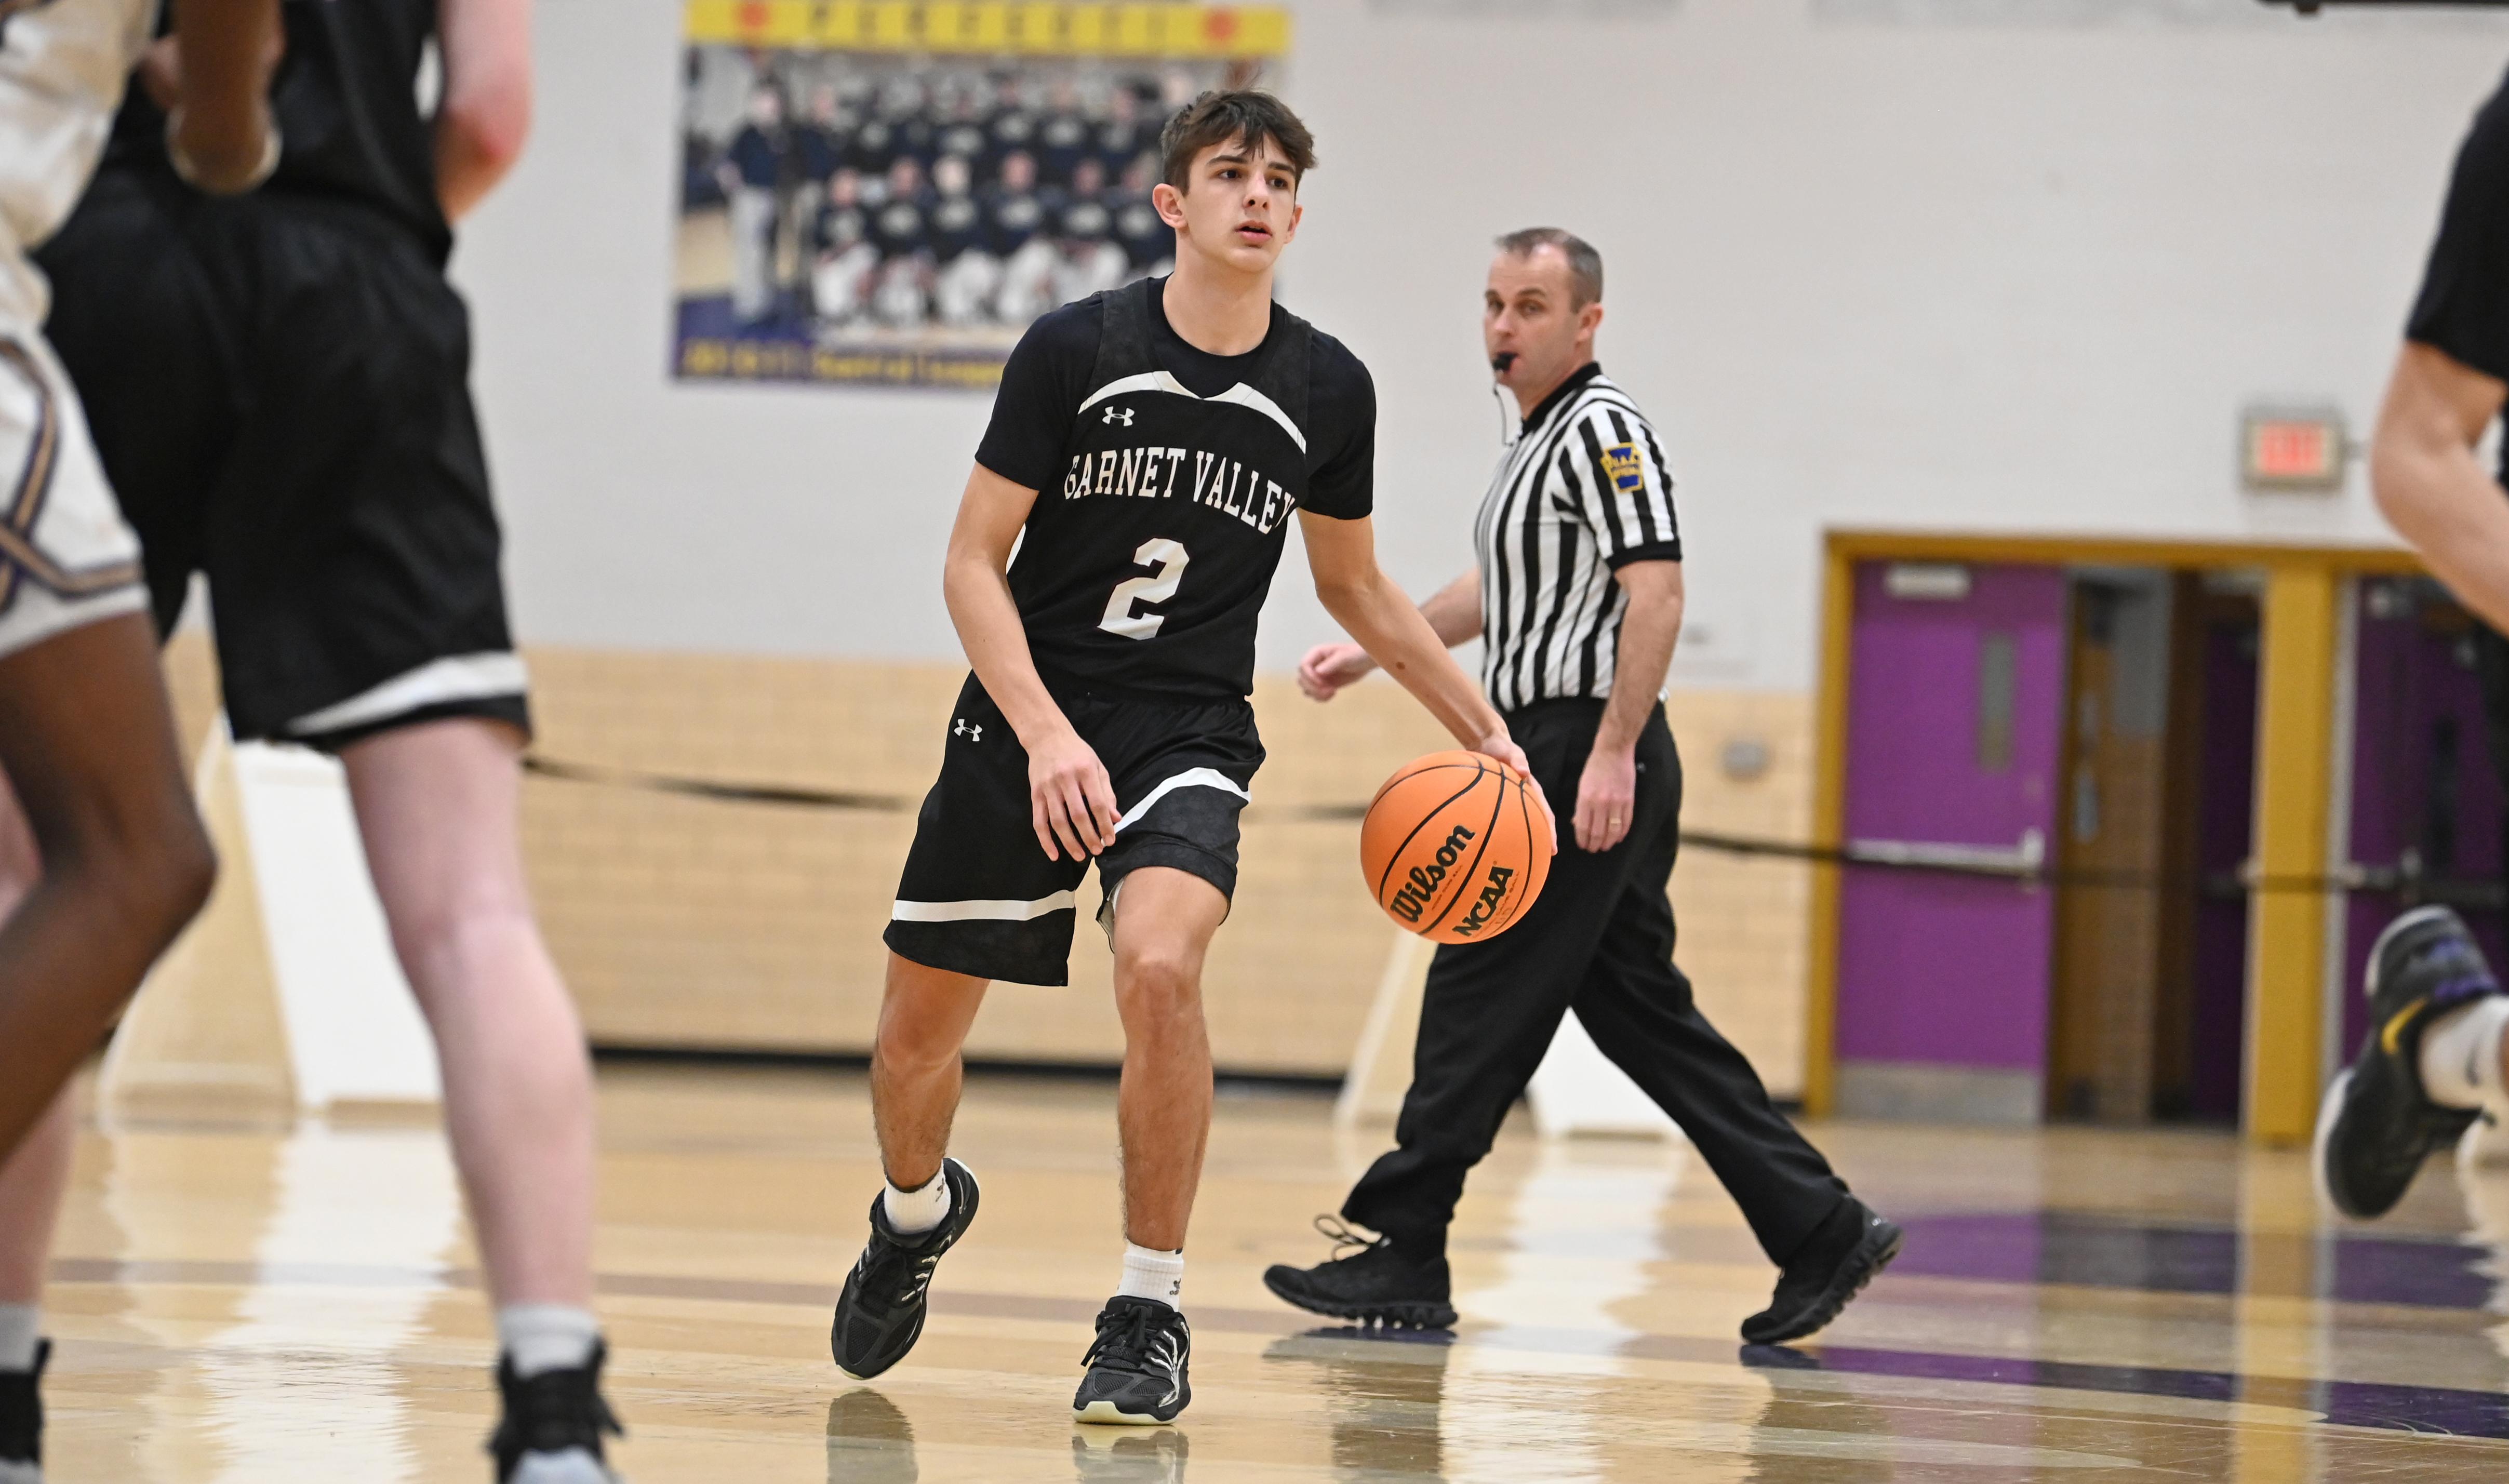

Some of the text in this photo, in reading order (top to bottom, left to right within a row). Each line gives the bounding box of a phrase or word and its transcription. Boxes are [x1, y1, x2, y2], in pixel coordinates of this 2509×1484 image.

[1064, 447, 1296, 534] GARNET VALLEY
[1097, 537, 1190, 640] 2
[1390, 825, 1475, 923] Wilson
[1452, 866, 1514, 936] NCAA
